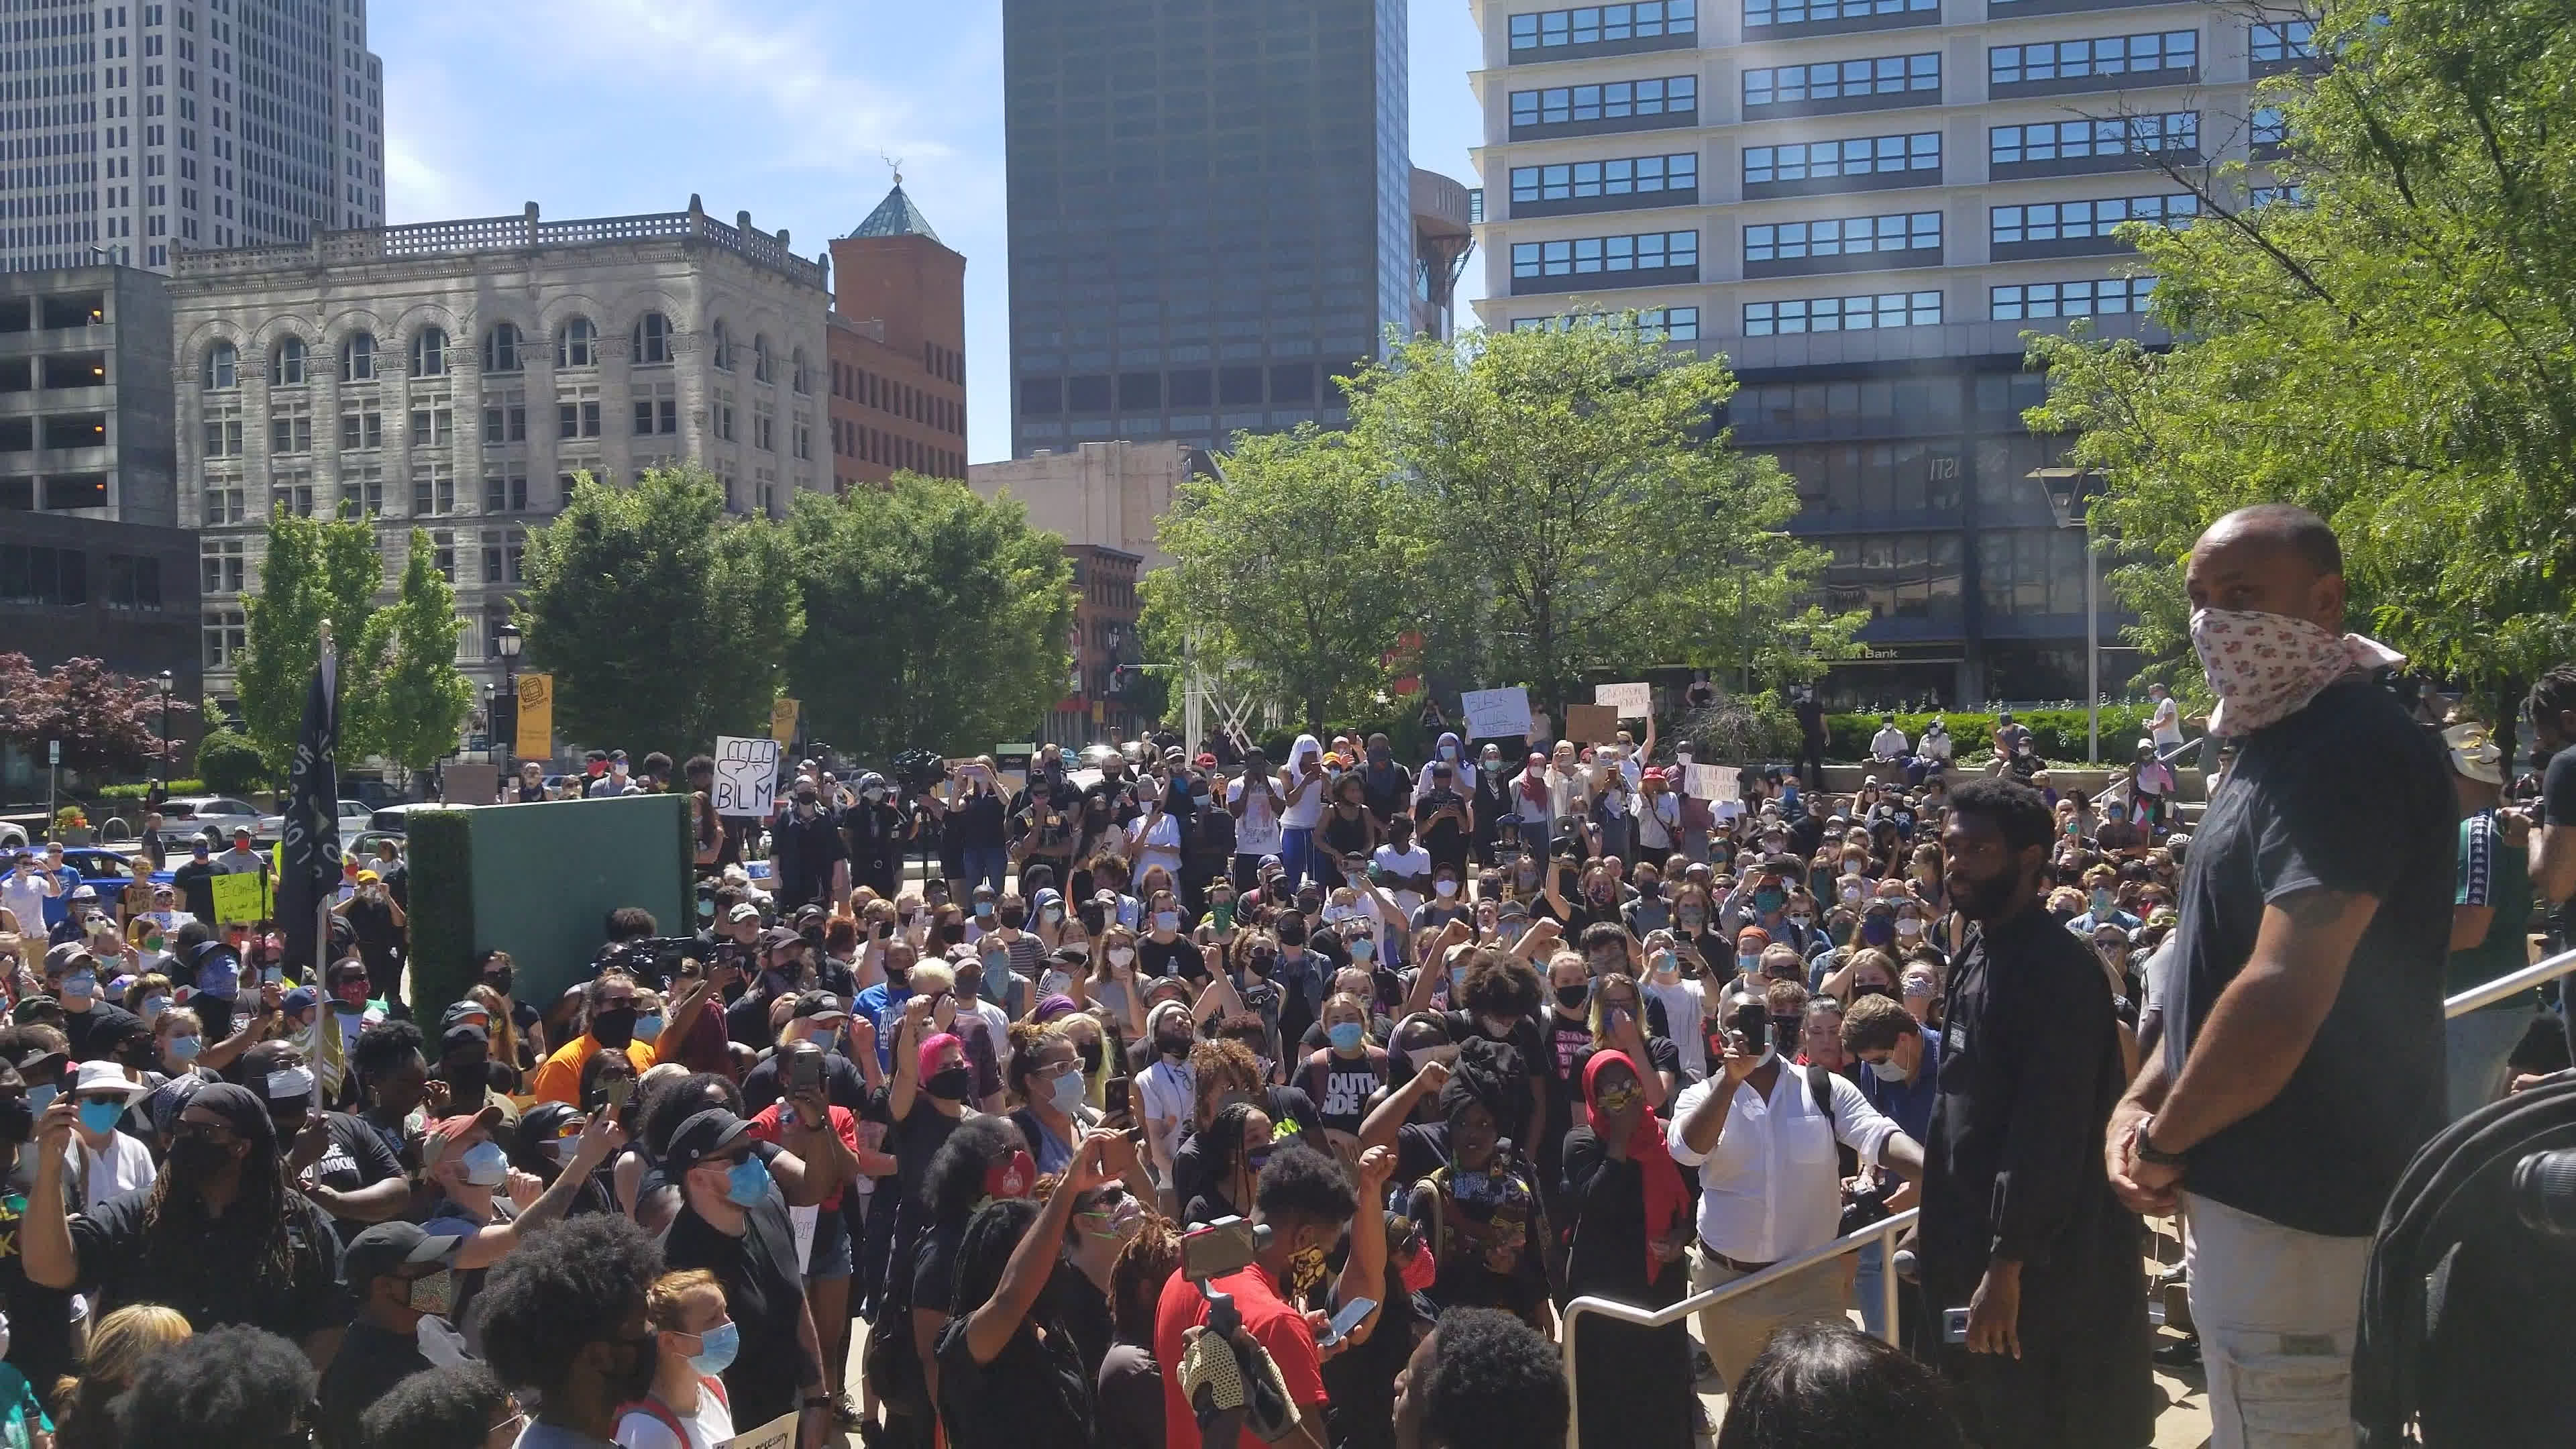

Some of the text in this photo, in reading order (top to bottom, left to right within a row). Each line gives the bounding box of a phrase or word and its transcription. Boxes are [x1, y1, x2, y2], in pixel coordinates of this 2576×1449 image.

[1865, 649, 1898, 659] Bank
[714, 783, 771, 810] BLM
[1328, 1072, 1379, 1095] OUTH
